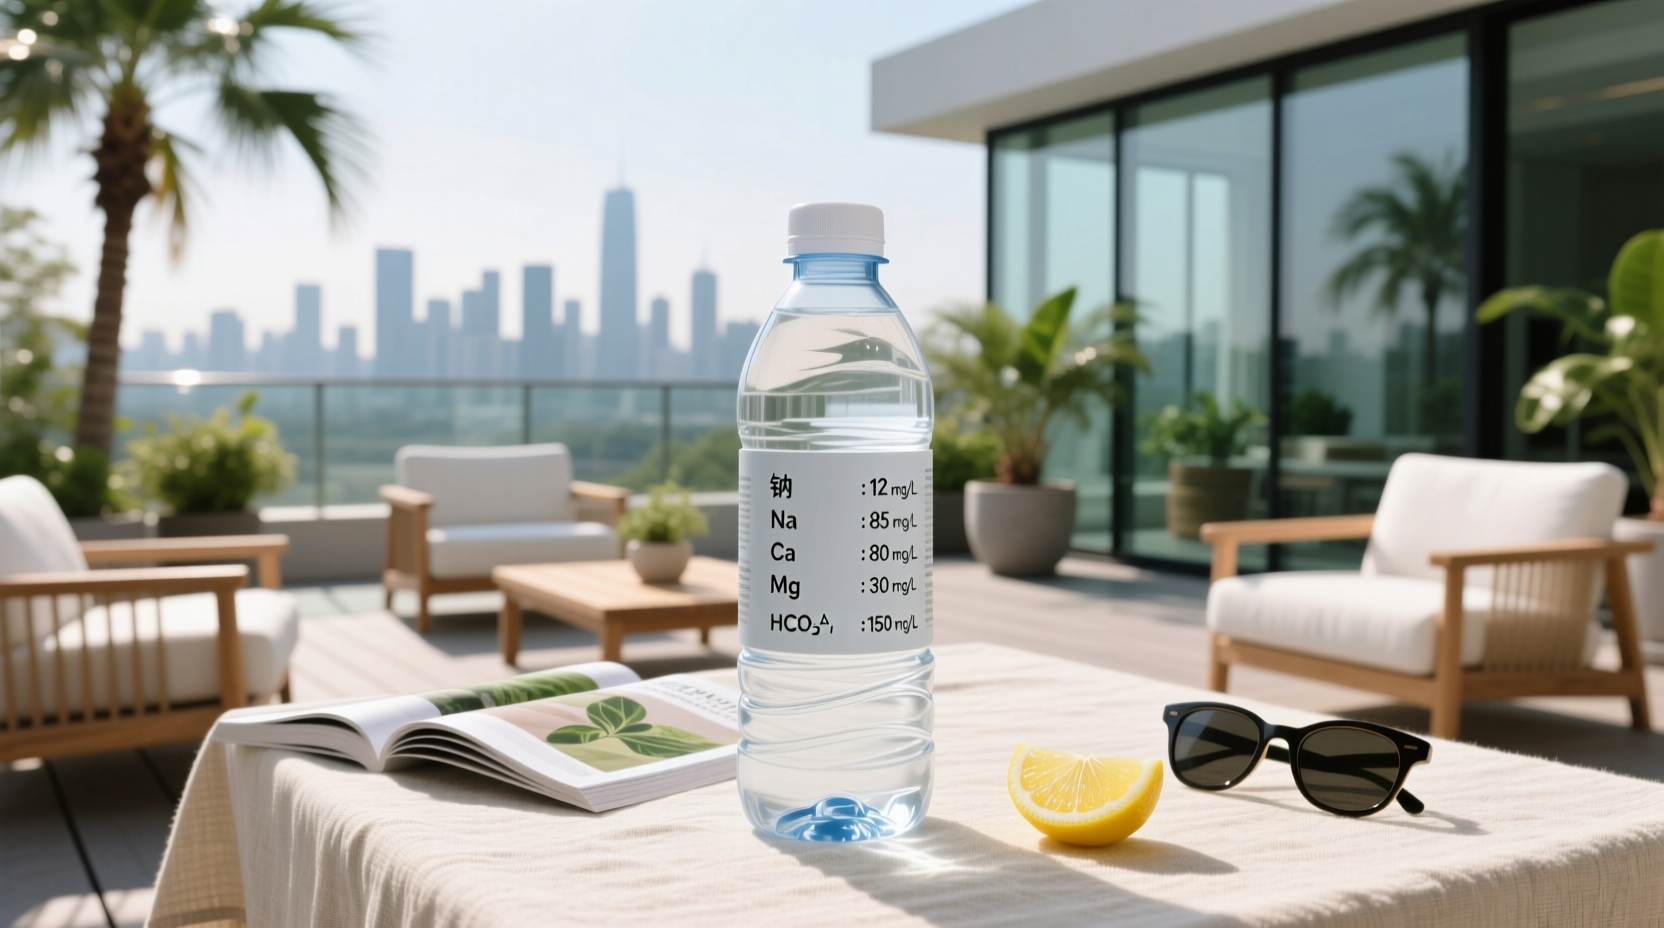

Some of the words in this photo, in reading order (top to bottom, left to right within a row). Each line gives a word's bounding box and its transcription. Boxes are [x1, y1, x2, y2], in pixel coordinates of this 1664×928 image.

[769, 472, 793, 500] 钠
[770, 508, 798, 531] Na
[770, 541, 796, 562] Ca
[770, 574, 801, 601] Mg
